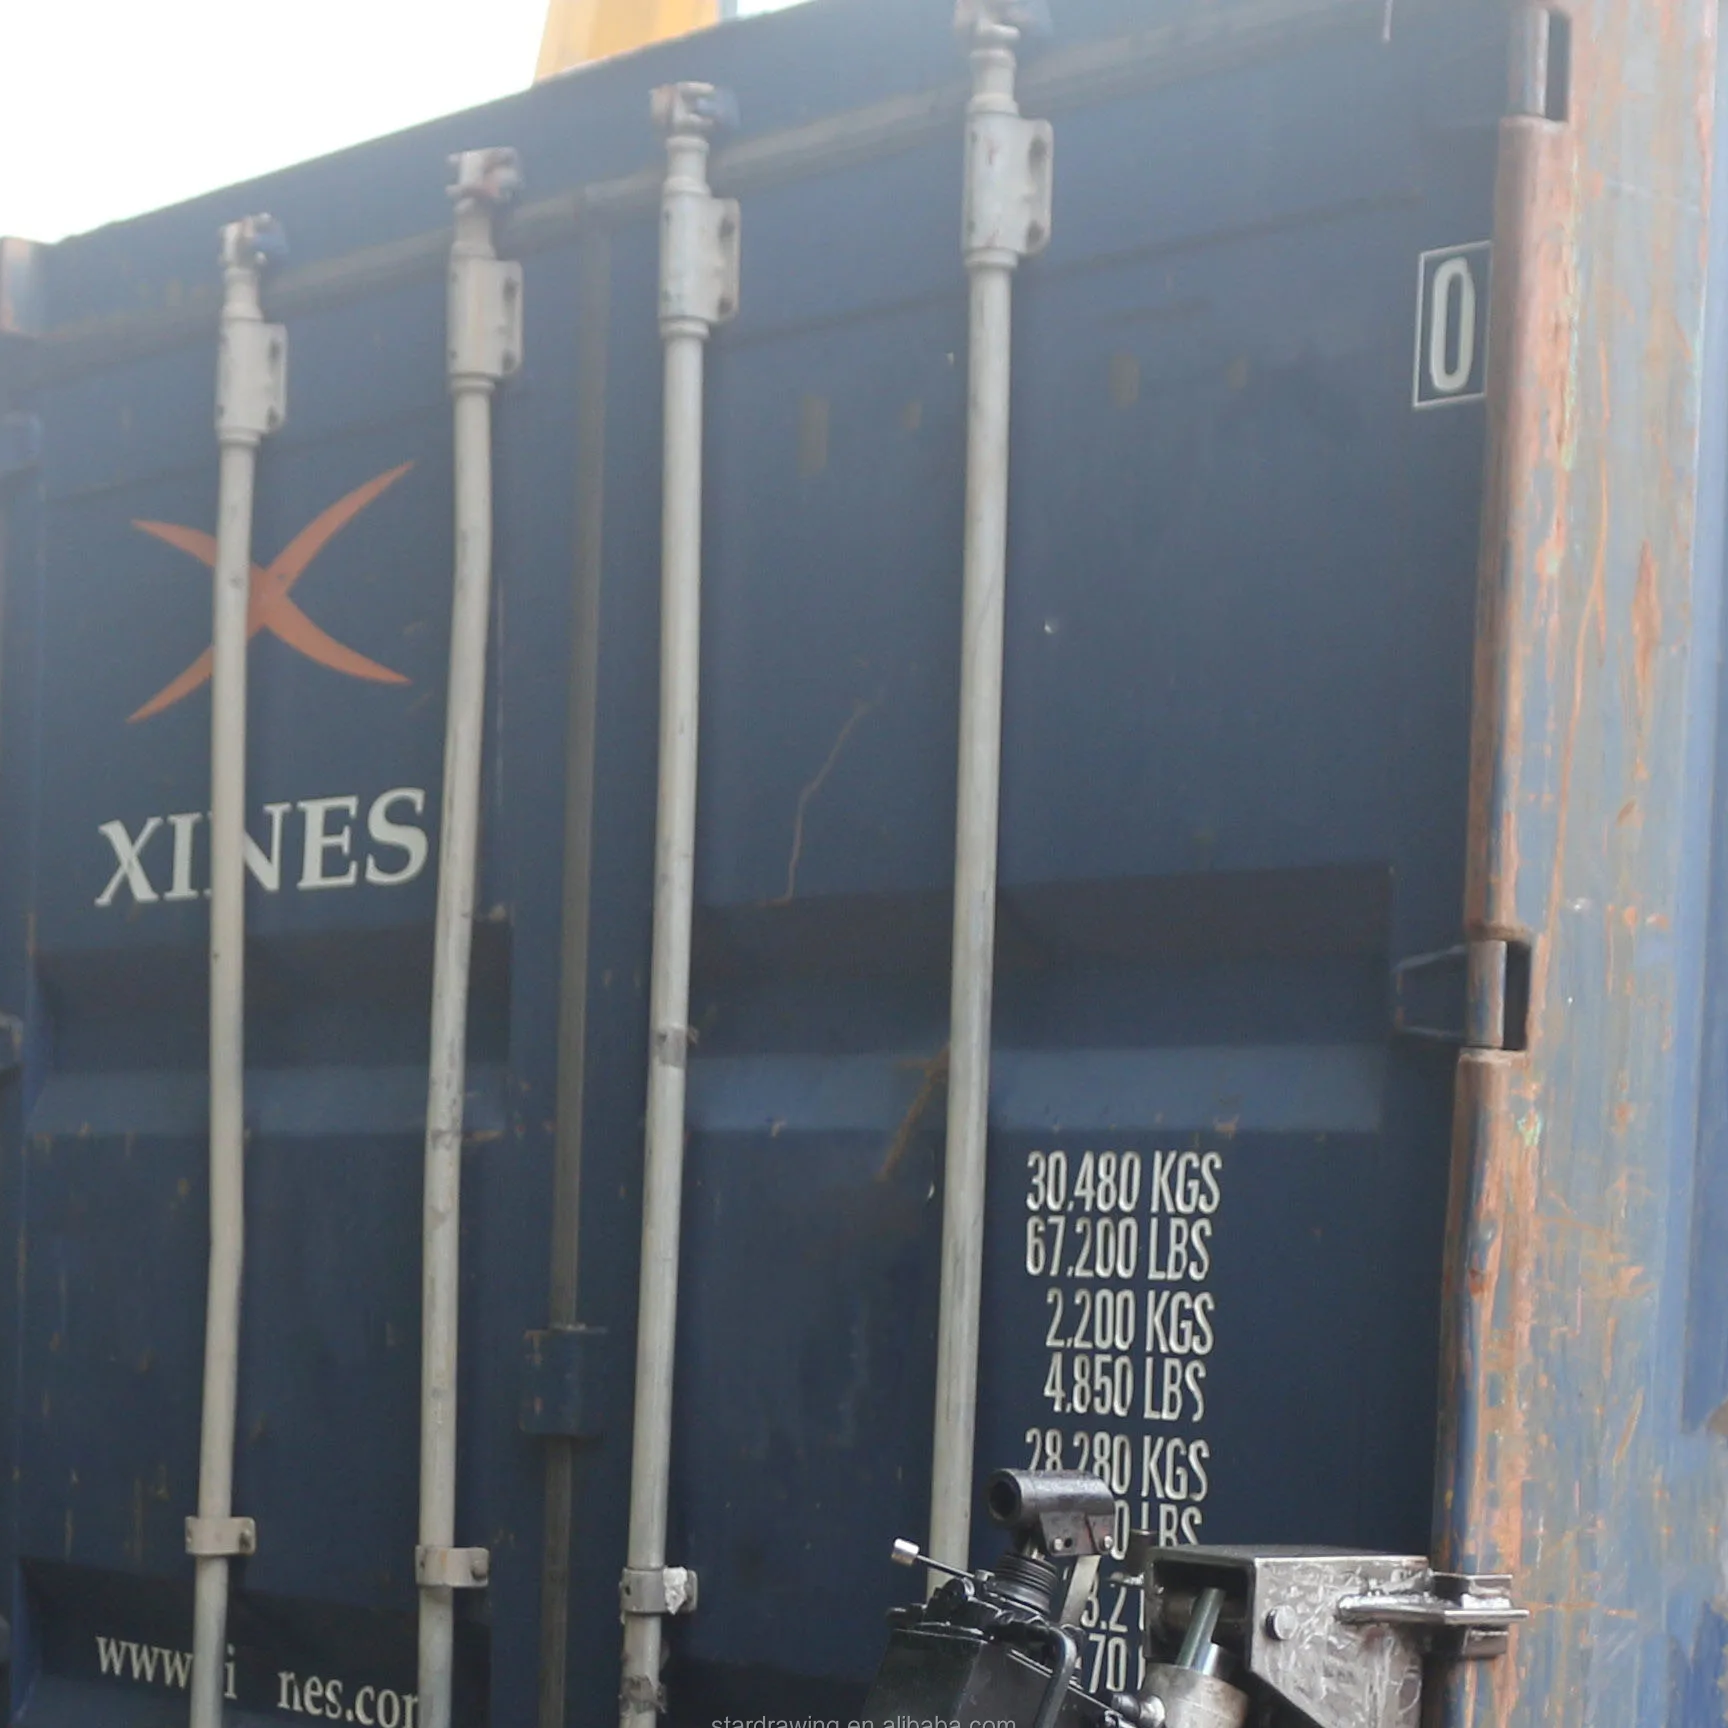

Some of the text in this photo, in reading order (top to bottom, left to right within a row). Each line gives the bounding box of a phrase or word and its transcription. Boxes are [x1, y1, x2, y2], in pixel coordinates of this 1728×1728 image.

[95, 788, 429, 906] XINES
[1150, 1151, 1222, 1214] KGS
[1147, 1218, 1213, 1281] LBS
[1145, 1290, 1215, 1354] KGS
[1143, 1357, 1207, 1422] LBS
[1141, 1435, 1210, 1502] KGS
